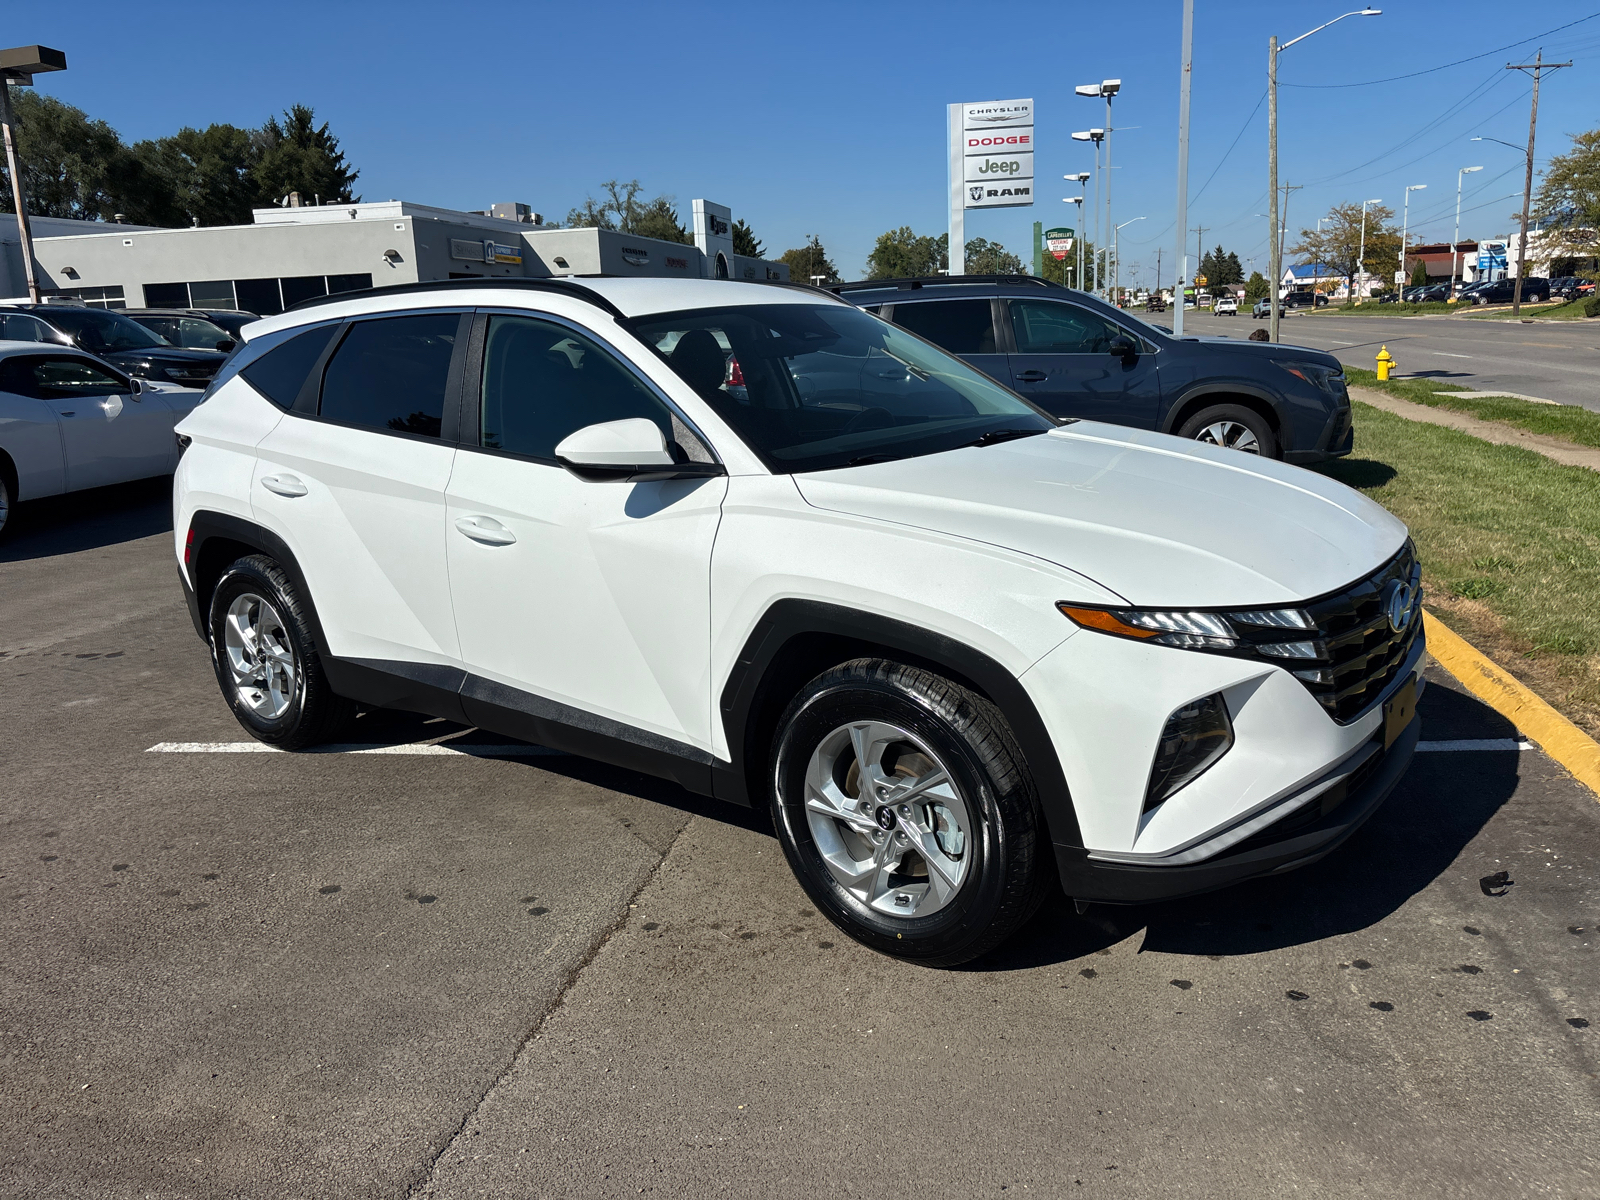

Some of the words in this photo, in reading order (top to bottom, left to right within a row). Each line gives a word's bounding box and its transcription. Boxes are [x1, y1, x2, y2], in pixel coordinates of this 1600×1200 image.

[969, 106, 1029, 115] CHRYSLER
[968, 135, 1030, 147] DODGE
[978, 159, 1020, 175] Jeep
[986, 187, 1030, 197] RAM
